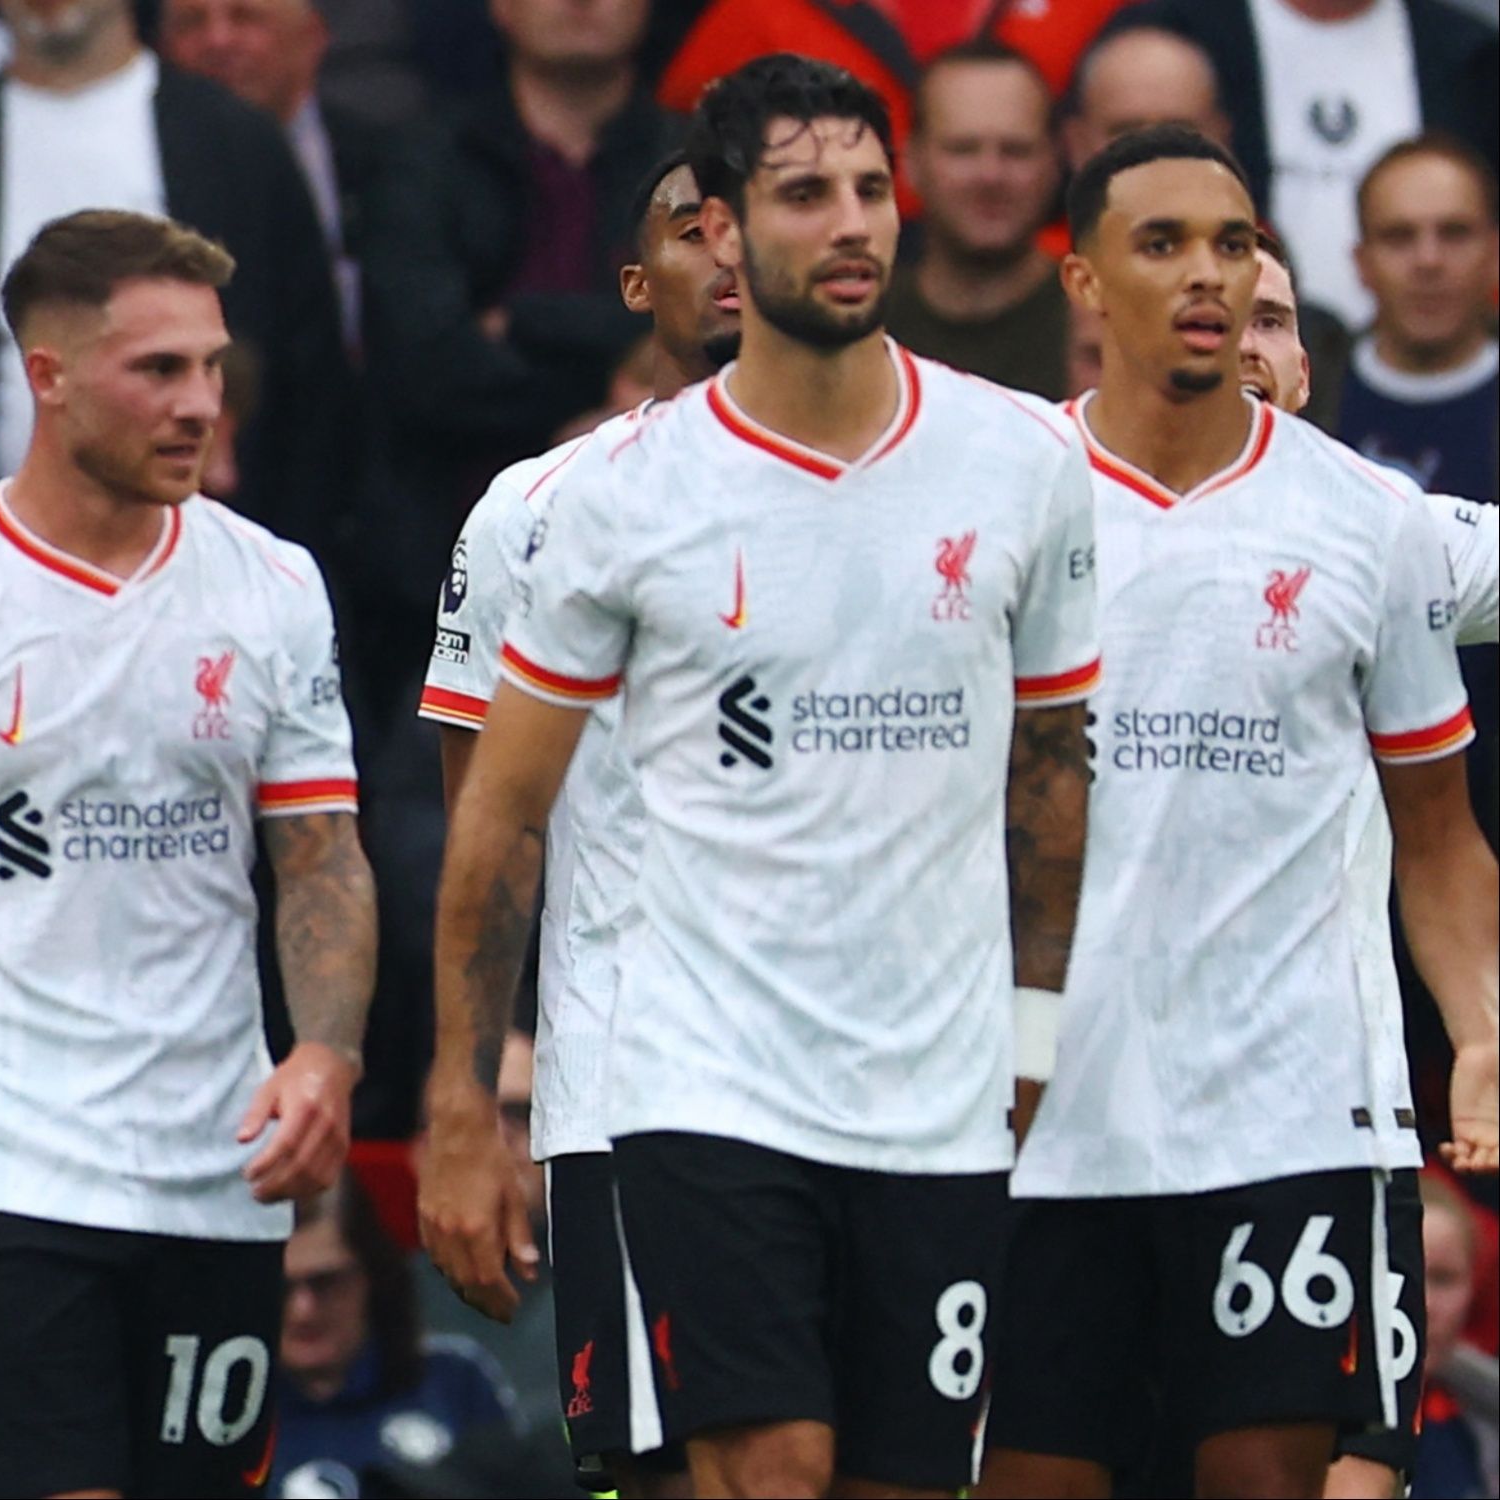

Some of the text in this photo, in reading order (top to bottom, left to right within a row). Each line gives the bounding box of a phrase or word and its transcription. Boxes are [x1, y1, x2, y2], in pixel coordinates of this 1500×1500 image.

[792, 687, 965, 723] standard
[792, 720, 971, 753] chartered
[1113, 708, 1283, 744] standard
[1112, 739, 1286, 777] chartered
[59, 793, 224, 829] standard
[62, 824, 231, 862] chartered
[1213, 1214, 1356, 1338] 66
[928, 1280, 988, 1400] 8
[160, 1334, 270, 1447] 10
